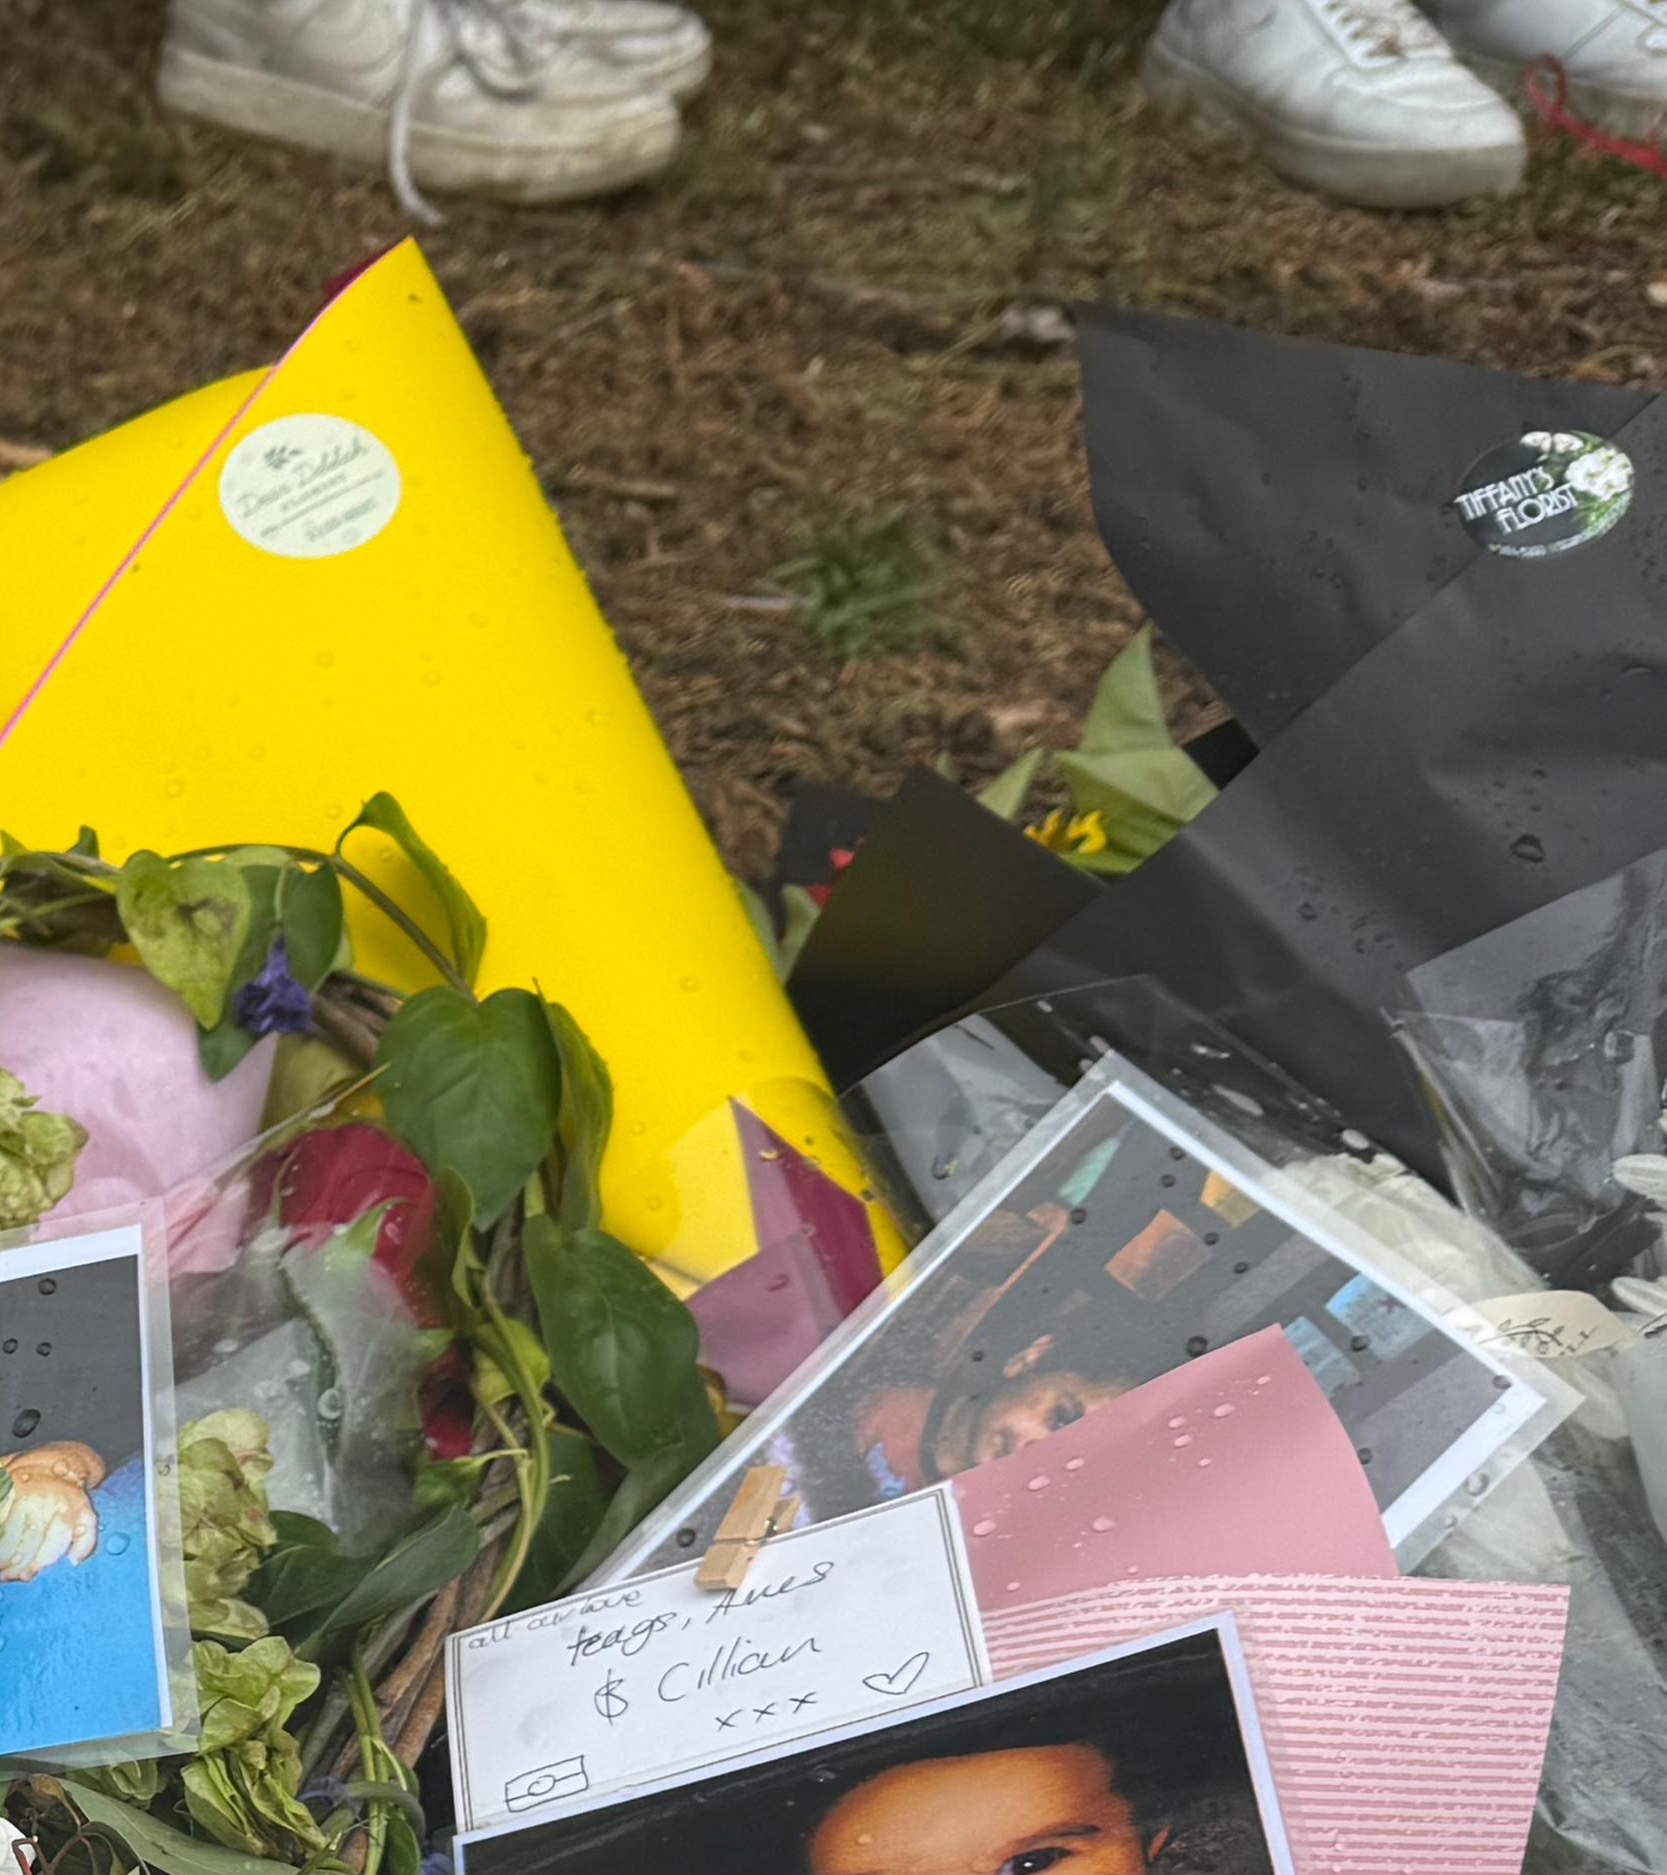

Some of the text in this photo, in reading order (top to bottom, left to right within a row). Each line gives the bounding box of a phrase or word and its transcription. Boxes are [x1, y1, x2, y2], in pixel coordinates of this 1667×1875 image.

[1453, 465, 1556, 520] TIFFANY'S
[1494, 482, 1579, 535] FLORIST
[468, 1619, 513, 1650] all
